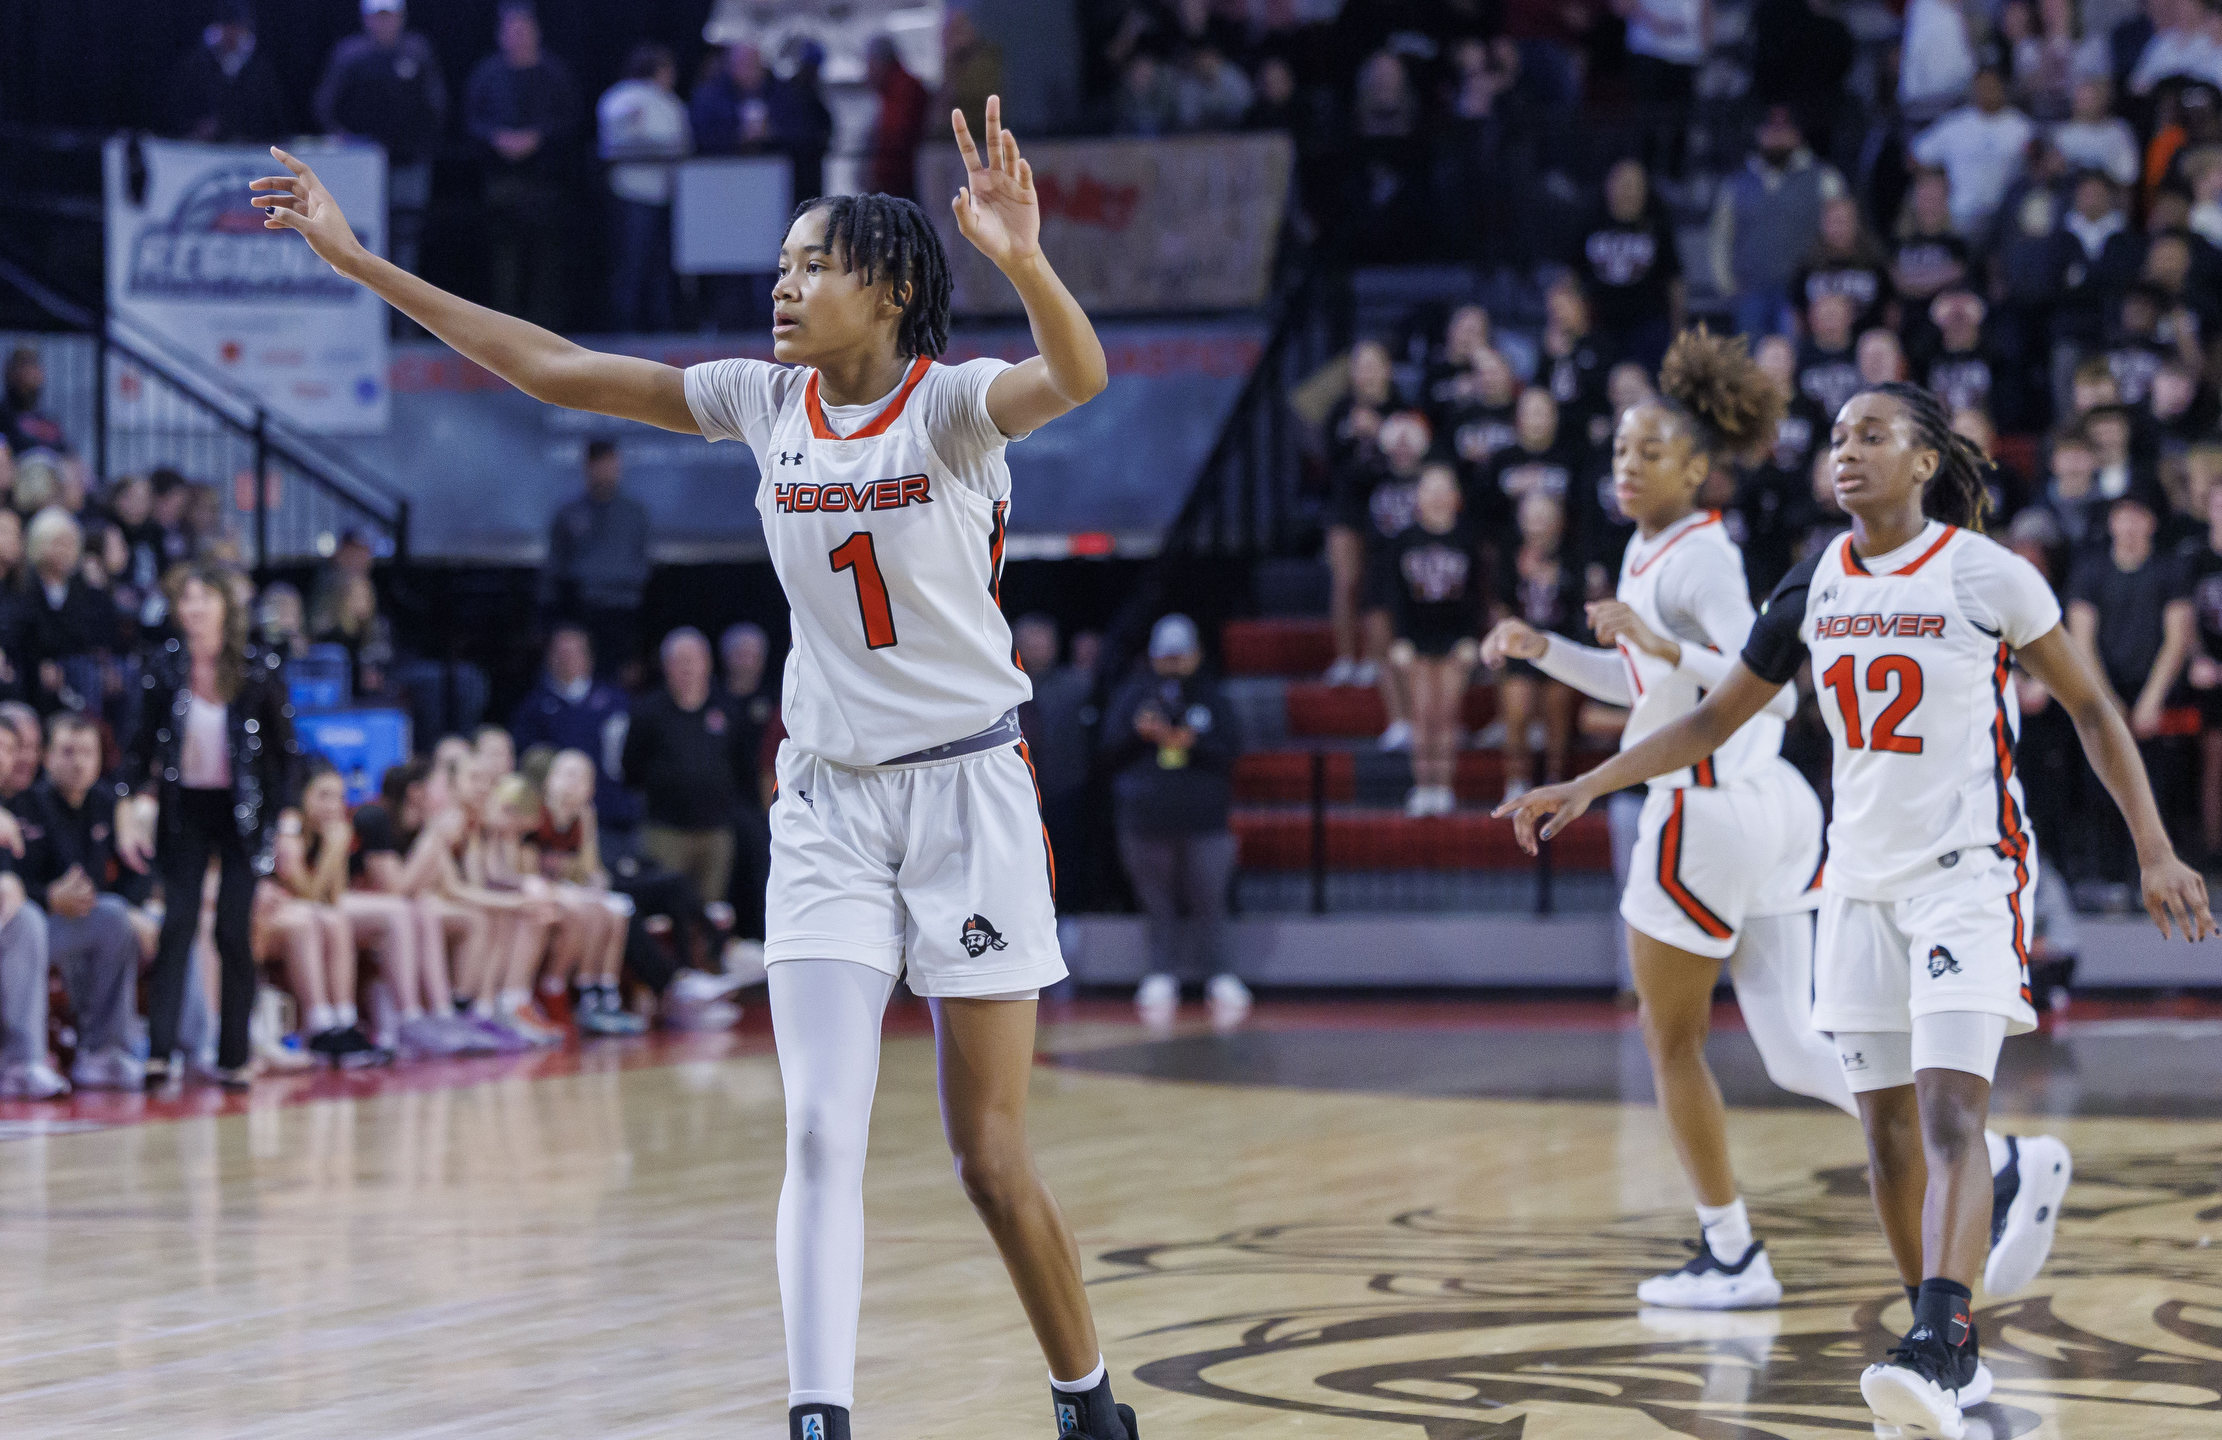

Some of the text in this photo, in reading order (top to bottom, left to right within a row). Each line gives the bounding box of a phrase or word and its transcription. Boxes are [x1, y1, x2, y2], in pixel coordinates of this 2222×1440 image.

[774, 473, 934, 513] HOOVER
[828, 531, 898, 650] 1
[1815, 613, 1945, 640] HOOVER
[1823, 654, 1923, 754] 12
